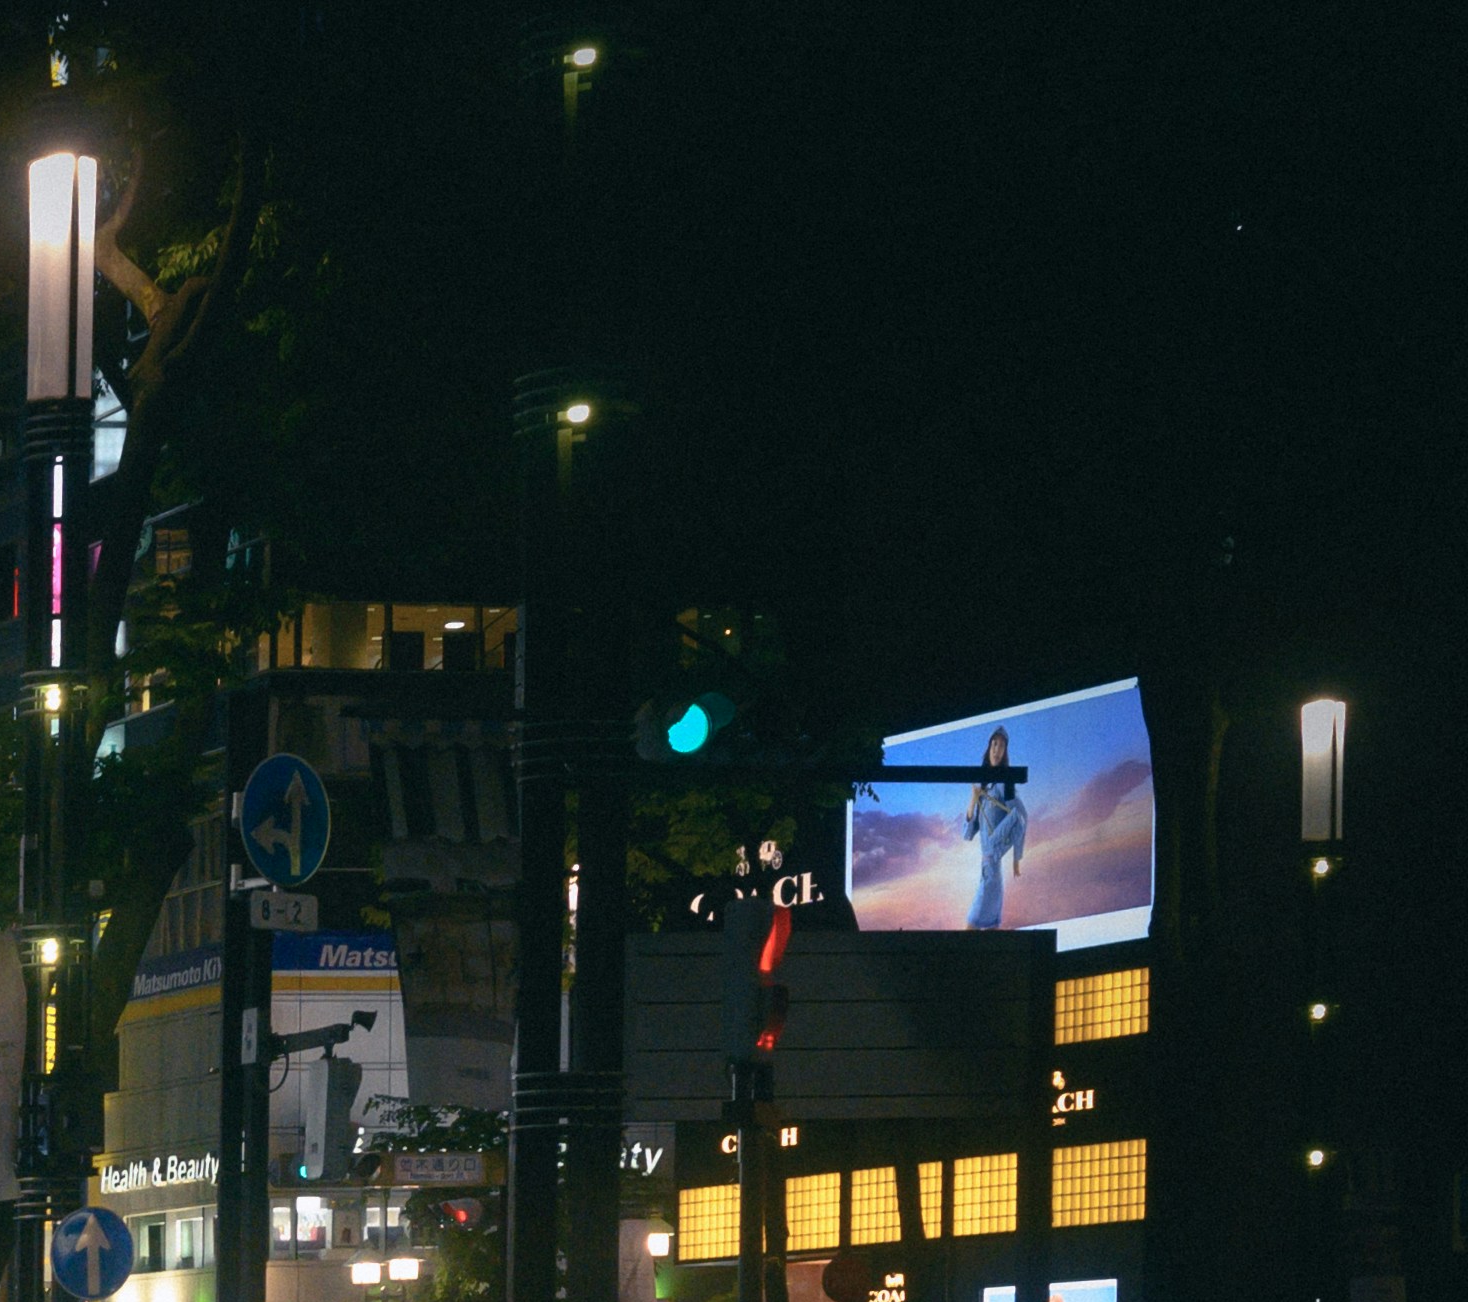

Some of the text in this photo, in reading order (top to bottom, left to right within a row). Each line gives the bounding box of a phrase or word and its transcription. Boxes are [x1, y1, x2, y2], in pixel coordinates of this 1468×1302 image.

[100, 1152, 220, 1195] Health & Beauty
